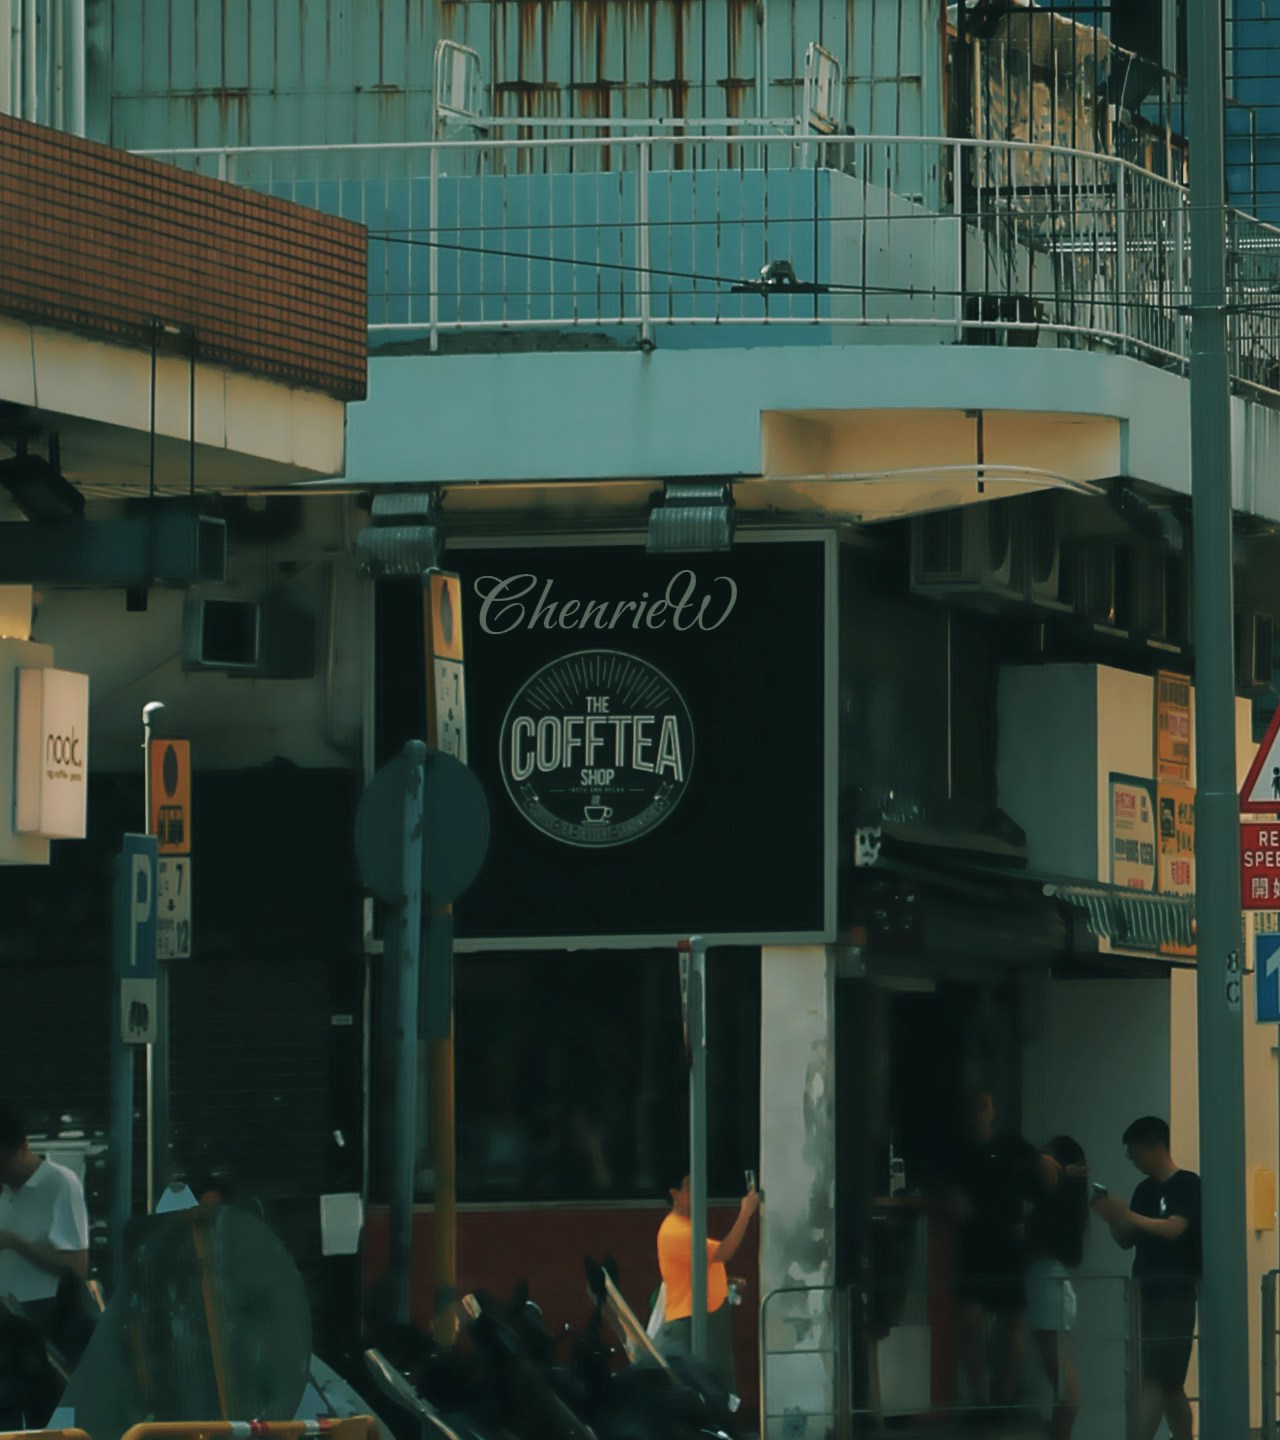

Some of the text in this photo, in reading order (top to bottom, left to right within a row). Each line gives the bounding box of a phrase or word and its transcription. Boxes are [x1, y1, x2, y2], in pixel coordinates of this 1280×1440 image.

[585, 696, 610, 713] THE
[511, 715, 683, 782] COFFTEA
[580, 769, 615, 786] SHOP
